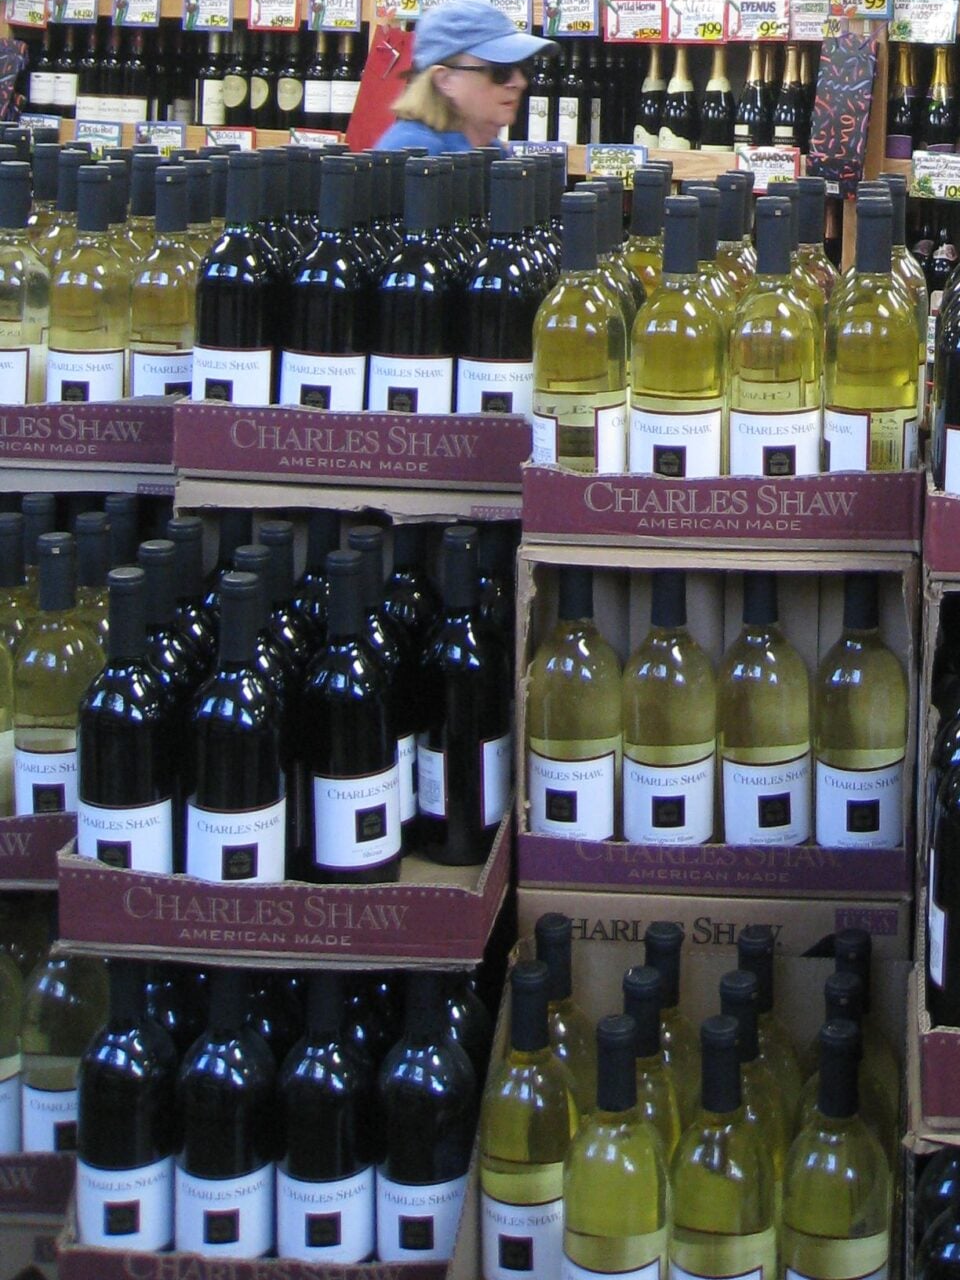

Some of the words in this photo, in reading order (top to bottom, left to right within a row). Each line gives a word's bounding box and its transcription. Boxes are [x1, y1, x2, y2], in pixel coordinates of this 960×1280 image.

[230, 418, 381, 456] CHARLES
[387, 426, 482, 459] SHAW
[738, 422, 789, 436] CHARLES
[51, 442, 98, 456] MADE
[279, 455, 374, 471] AMERICAN
[380, 459, 429, 473] MADE
[584, 481, 749, 516] CHARLES
[756, 484, 859, 518] SHAW
[637, 517, 740, 530] AMERICAN
[745, 519, 802, 531] MADE
[122, 885, 294, 927] CHARLES
[303, 895, 409, 932] SHAW
[179, 927, 287, 943] AMERICAN
[294, 932, 352, 947] MADE
